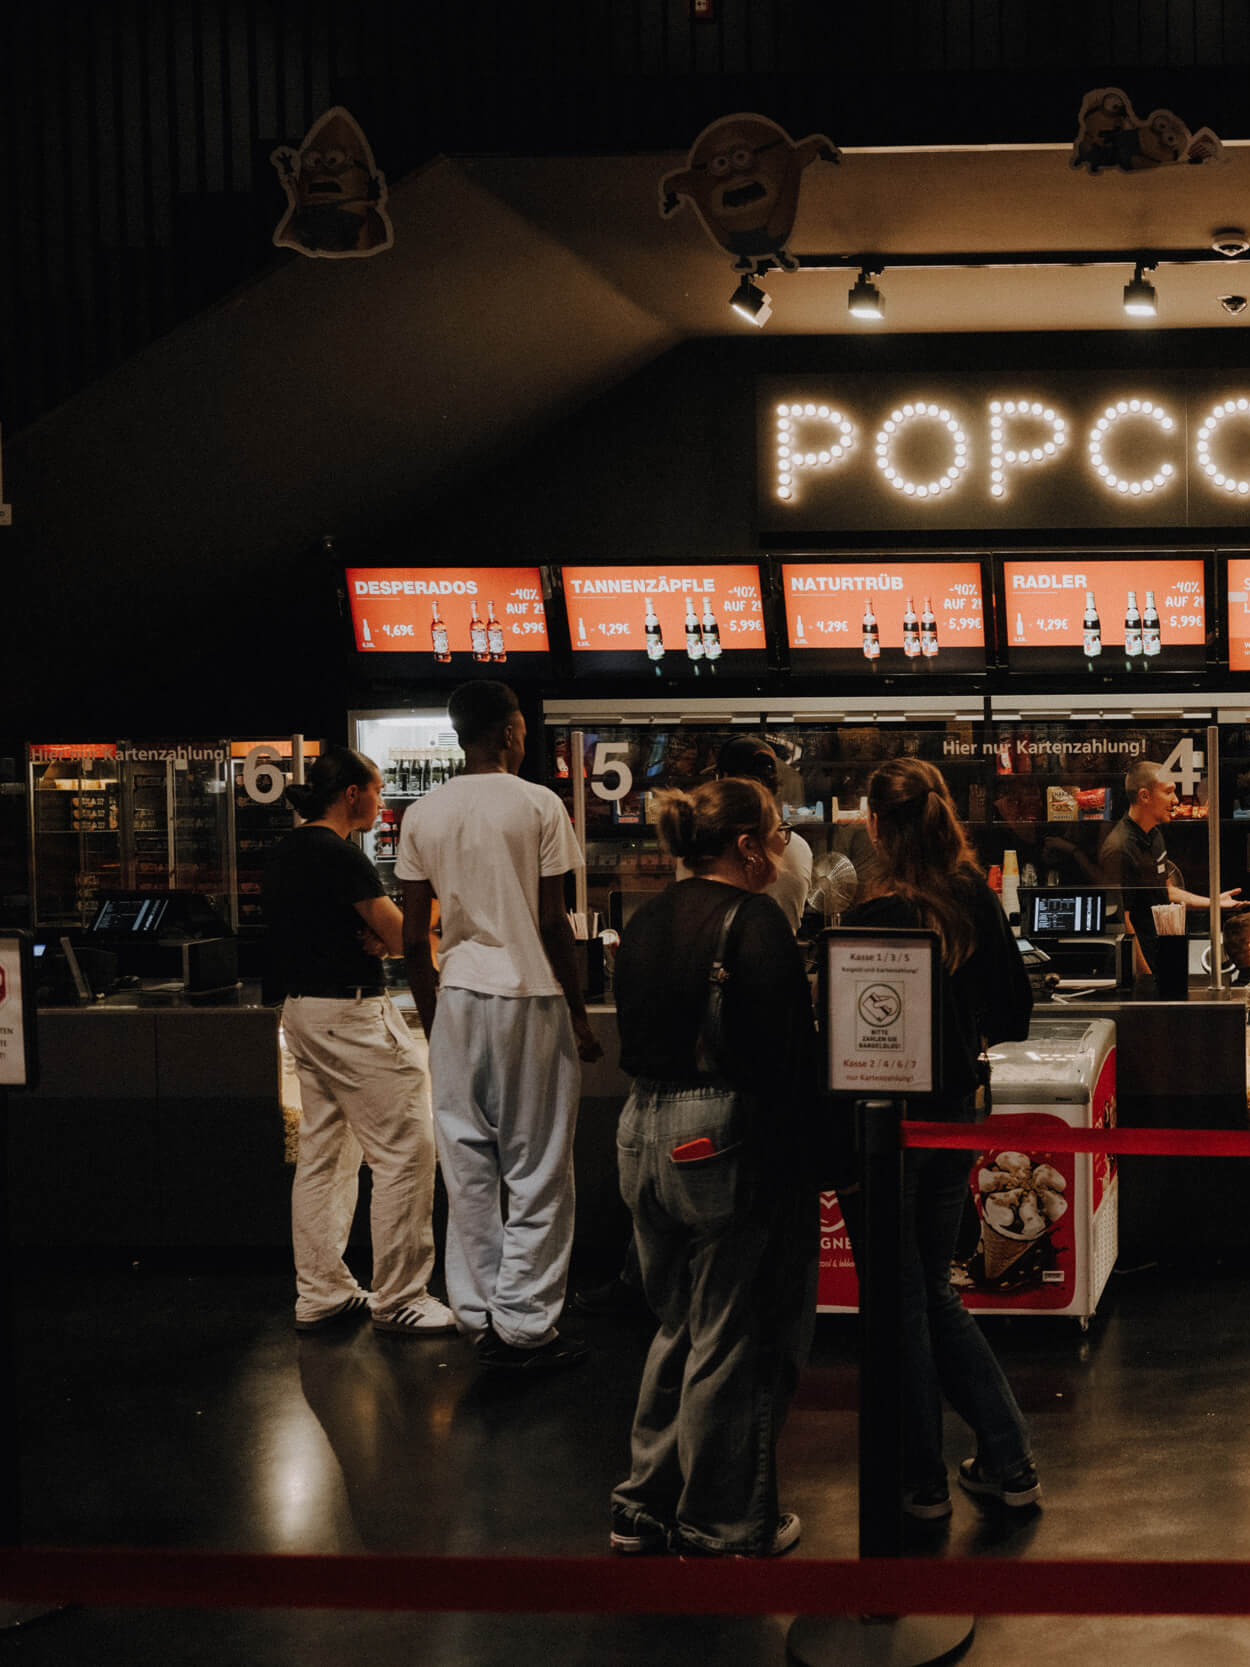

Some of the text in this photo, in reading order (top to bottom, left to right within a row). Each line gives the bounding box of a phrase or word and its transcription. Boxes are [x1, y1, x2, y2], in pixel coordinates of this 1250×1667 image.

[355, 580, 478, 594] DESPERADOS
[571, 576, 716, 593] TANNENZÄPFLE
[791, 573, 904, 591] NATURTRÜB
[1013, 575, 1087, 589] RADLER
[1171, 581, 1201, 593] -40%
[510, 589, 539, 600] -40%
[728, 586, 757, 598] -40%
[948, 584, 977, 595] -40%
[723, 600, 746, 612] AUF
[944, 598, 966, 610] AUF
[1165, 596, 1187, 608] AUF
[506, 603, 529, 614] AUF
[943, 738, 1147, 757] Hier nur Kartenzahlung!
[31, 748, 64, 762] Hier
[103, 745, 231, 764] Kartenzahlung!
[591, 742, 633, 801] 5
[1156, 737, 1202, 796] 4
[243, 744, 285, 804] 6
[850, 953, 875, 961] Kasse
[843, 1060, 867, 1068] Kasse
